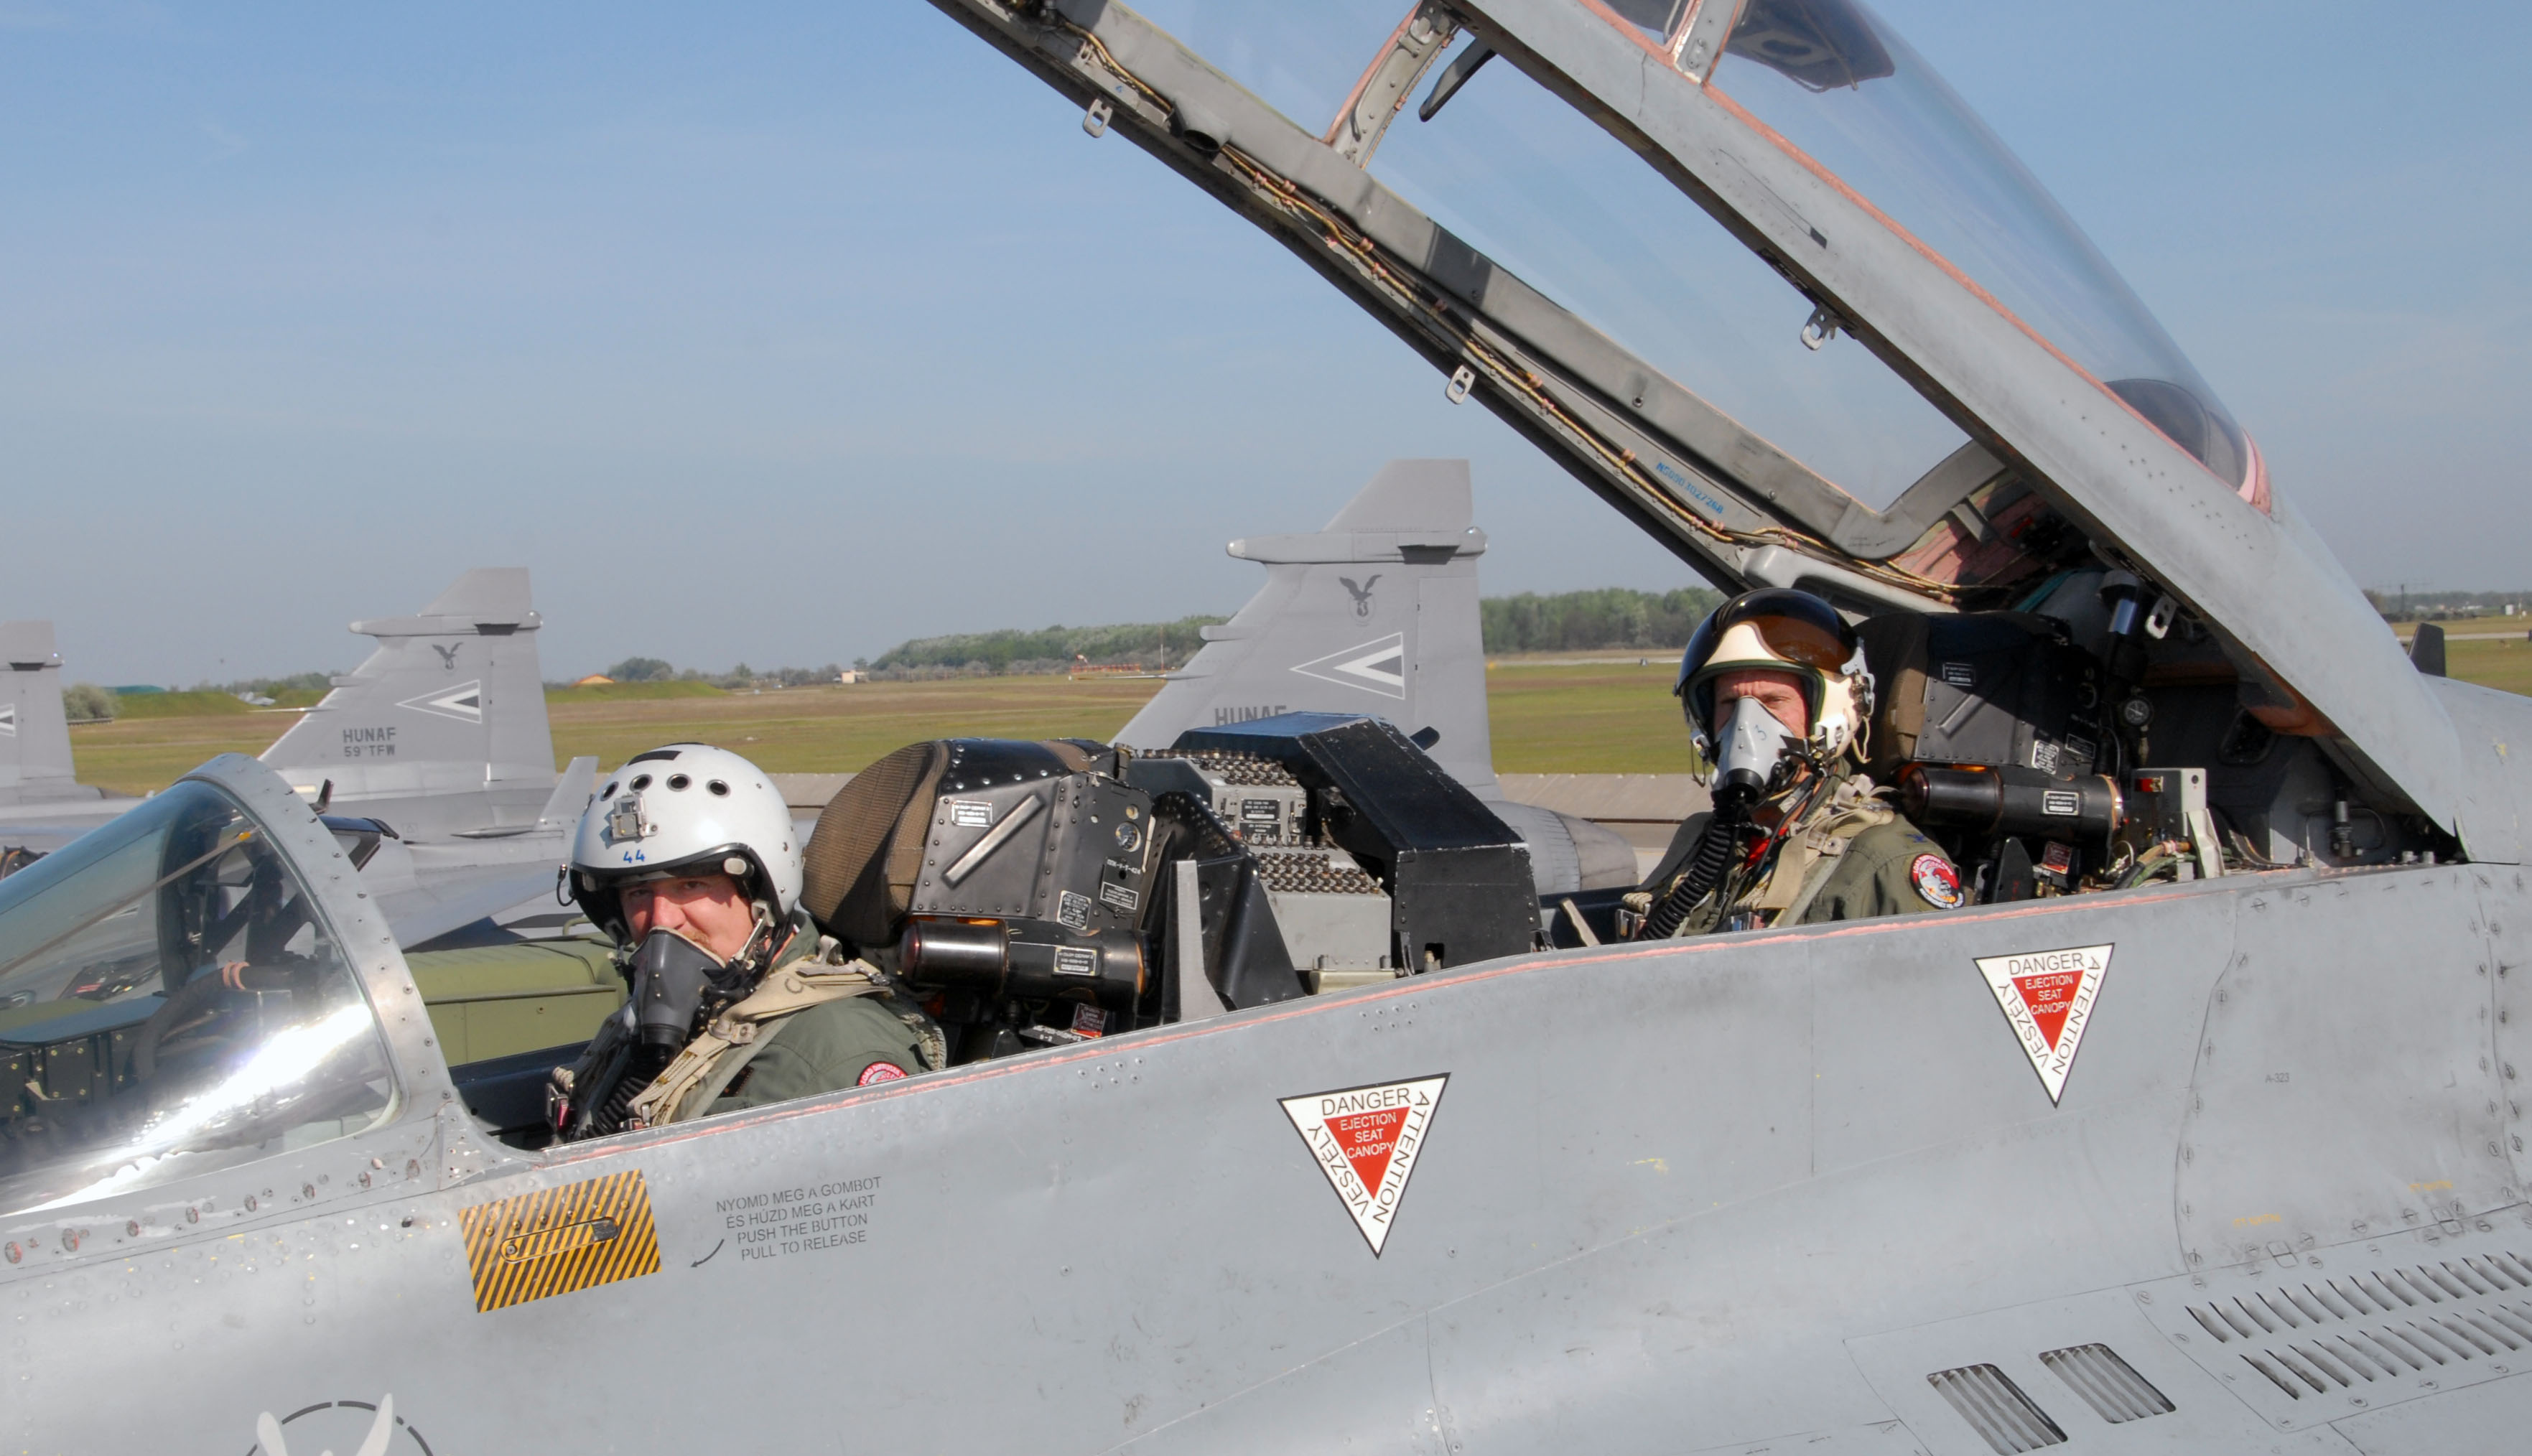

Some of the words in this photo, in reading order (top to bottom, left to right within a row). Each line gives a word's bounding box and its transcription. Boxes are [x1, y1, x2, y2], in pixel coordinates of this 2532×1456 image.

[343, 727, 396, 742] HUNAF
[369, 744, 396, 756] TFW
[623, 849, 645, 864] 44
[2009, 952, 2085, 976] DANGER
[2025, 974, 2073, 989] EJECTION
[2037, 989, 2062, 1001] SEAT
[2031, 1000, 2072, 1015] CANOPY
[2052, 956, 2101, 1075] ATTENTION
[1998, 983, 2049, 1068] VESZÉLY
[2265, 1072, 2289, 1083] A-323
[1322, 1087, 1411, 1116] DANGER
[1340, 1112, 1397, 1131] EJECTION
[1355, 1128, 1384, 1143] SEAT
[1346, 1142, 1395, 1159] CANOPY
[1372, 1091, 1430, 1224] ATTENTION
[1307, 1124, 1369, 1217] VESZÉLY
[717, 1194, 768, 1213] NYOMD
[773, 1188, 804, 1204] MEG
[809, 1187, 818, 1199] A
[821, 1176, 882, 1197] GOMBOT
[749, 1208, 787, 1226] HÚZD
[791, 1203, 823, 1218] MEG
[827, 1202, 836, 1213] A
[839, 1195, 875, 1210] KART
[737, 1227, 776, 1244] PUSH
[780, 1222, 808, 1237] THE
[811, 1213, 868, 1233] BUTTON
[741, 1245, 777, 1261] PULL
[781, 1241, 800, 1255] TO
[804, 1230, 867, 1251] RELEASE
